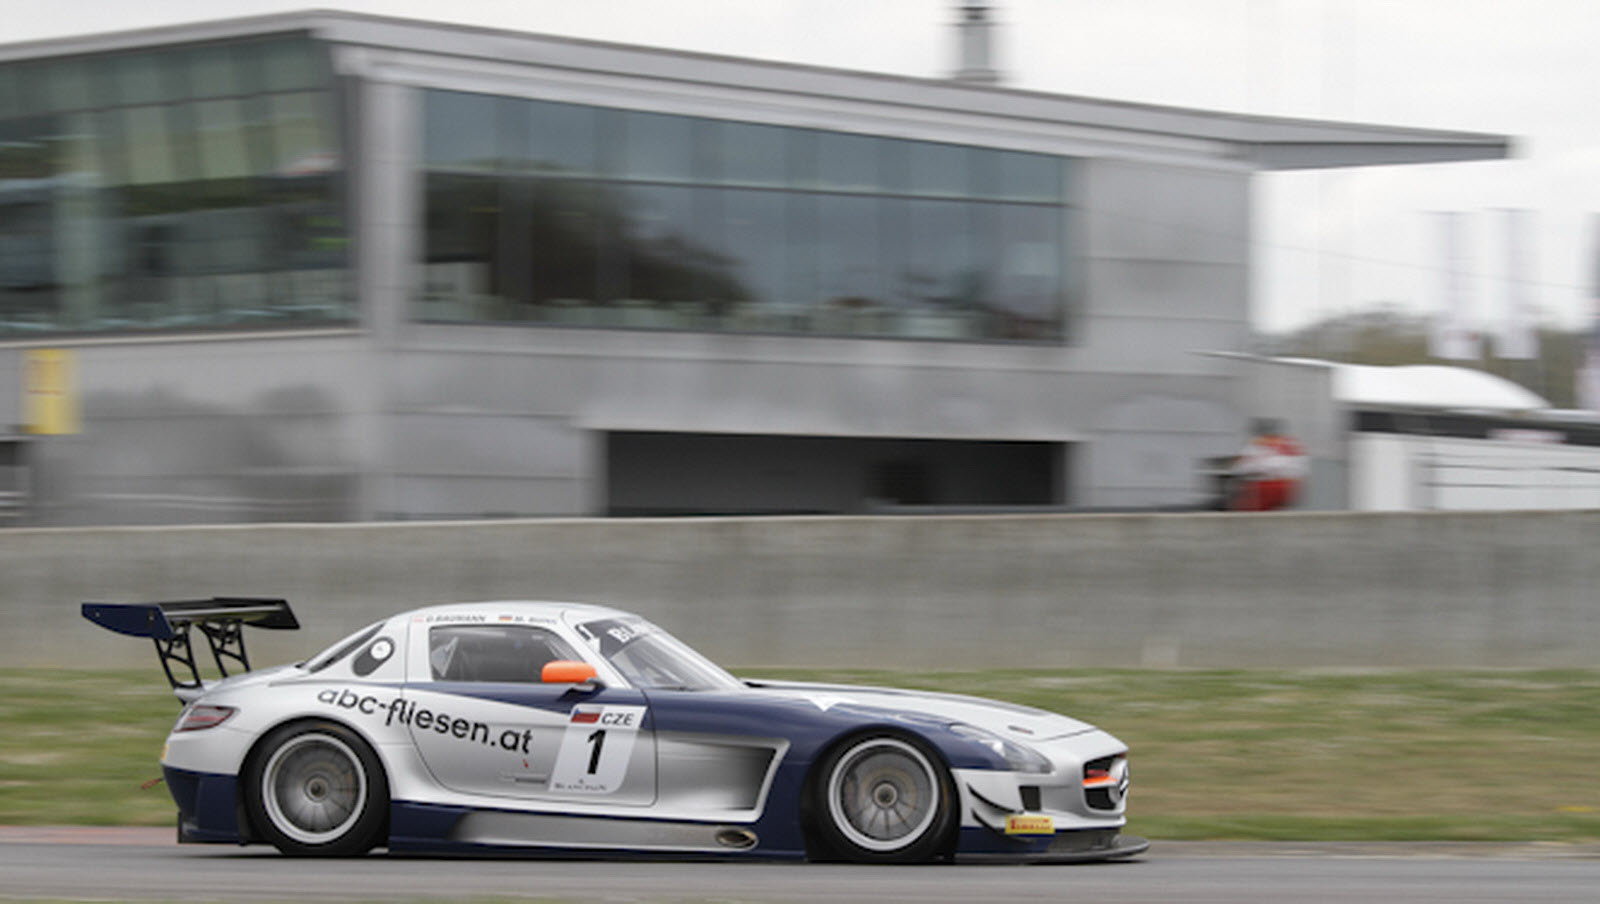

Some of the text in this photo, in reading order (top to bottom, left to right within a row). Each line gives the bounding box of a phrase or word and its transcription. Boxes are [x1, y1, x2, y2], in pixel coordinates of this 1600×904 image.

[317, 688, 533, 755] abc-fliesen.at
[601, 711, 635, 726] CZE
[586, 729, 607, 775] 1
